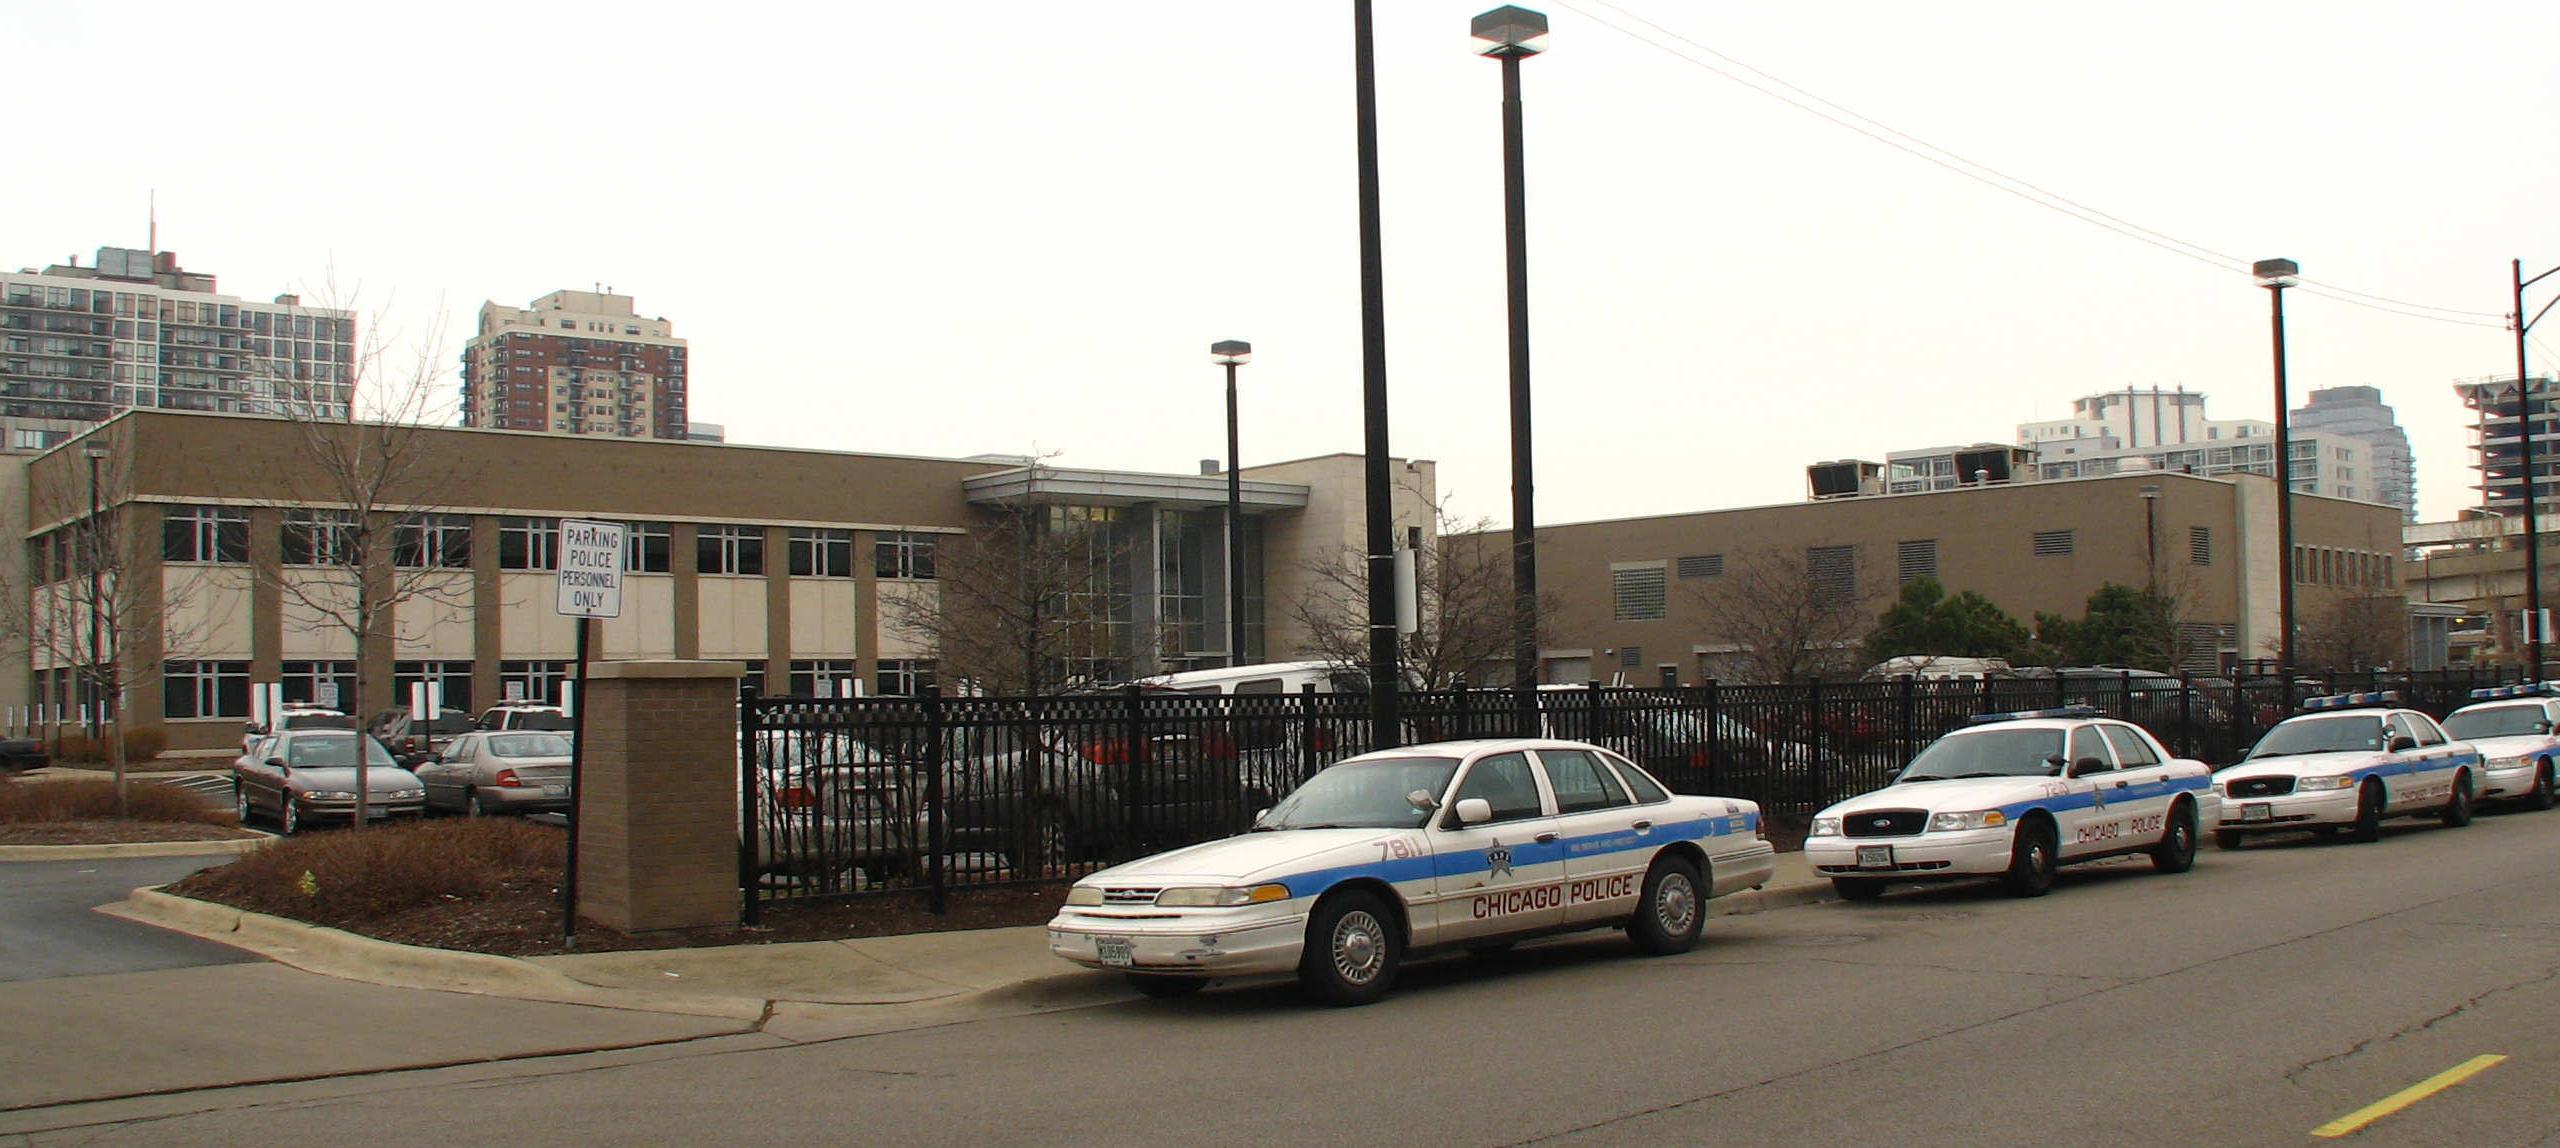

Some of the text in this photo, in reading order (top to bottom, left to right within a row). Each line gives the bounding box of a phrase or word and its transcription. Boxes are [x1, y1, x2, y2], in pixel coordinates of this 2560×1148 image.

[567, 528, 618, 548] PARKING
[570, 550, 612, 568] POLICE
[562, 570, 616, 588] PERSONNEL
[574, 590, 604, 608] ONLY
[2077, 815, 2161, 844] CHICAGO POLICE
[1372, 836, 1423, 862] 7811
[1473, 875, 1633, 919] CHICAGO POLICE
